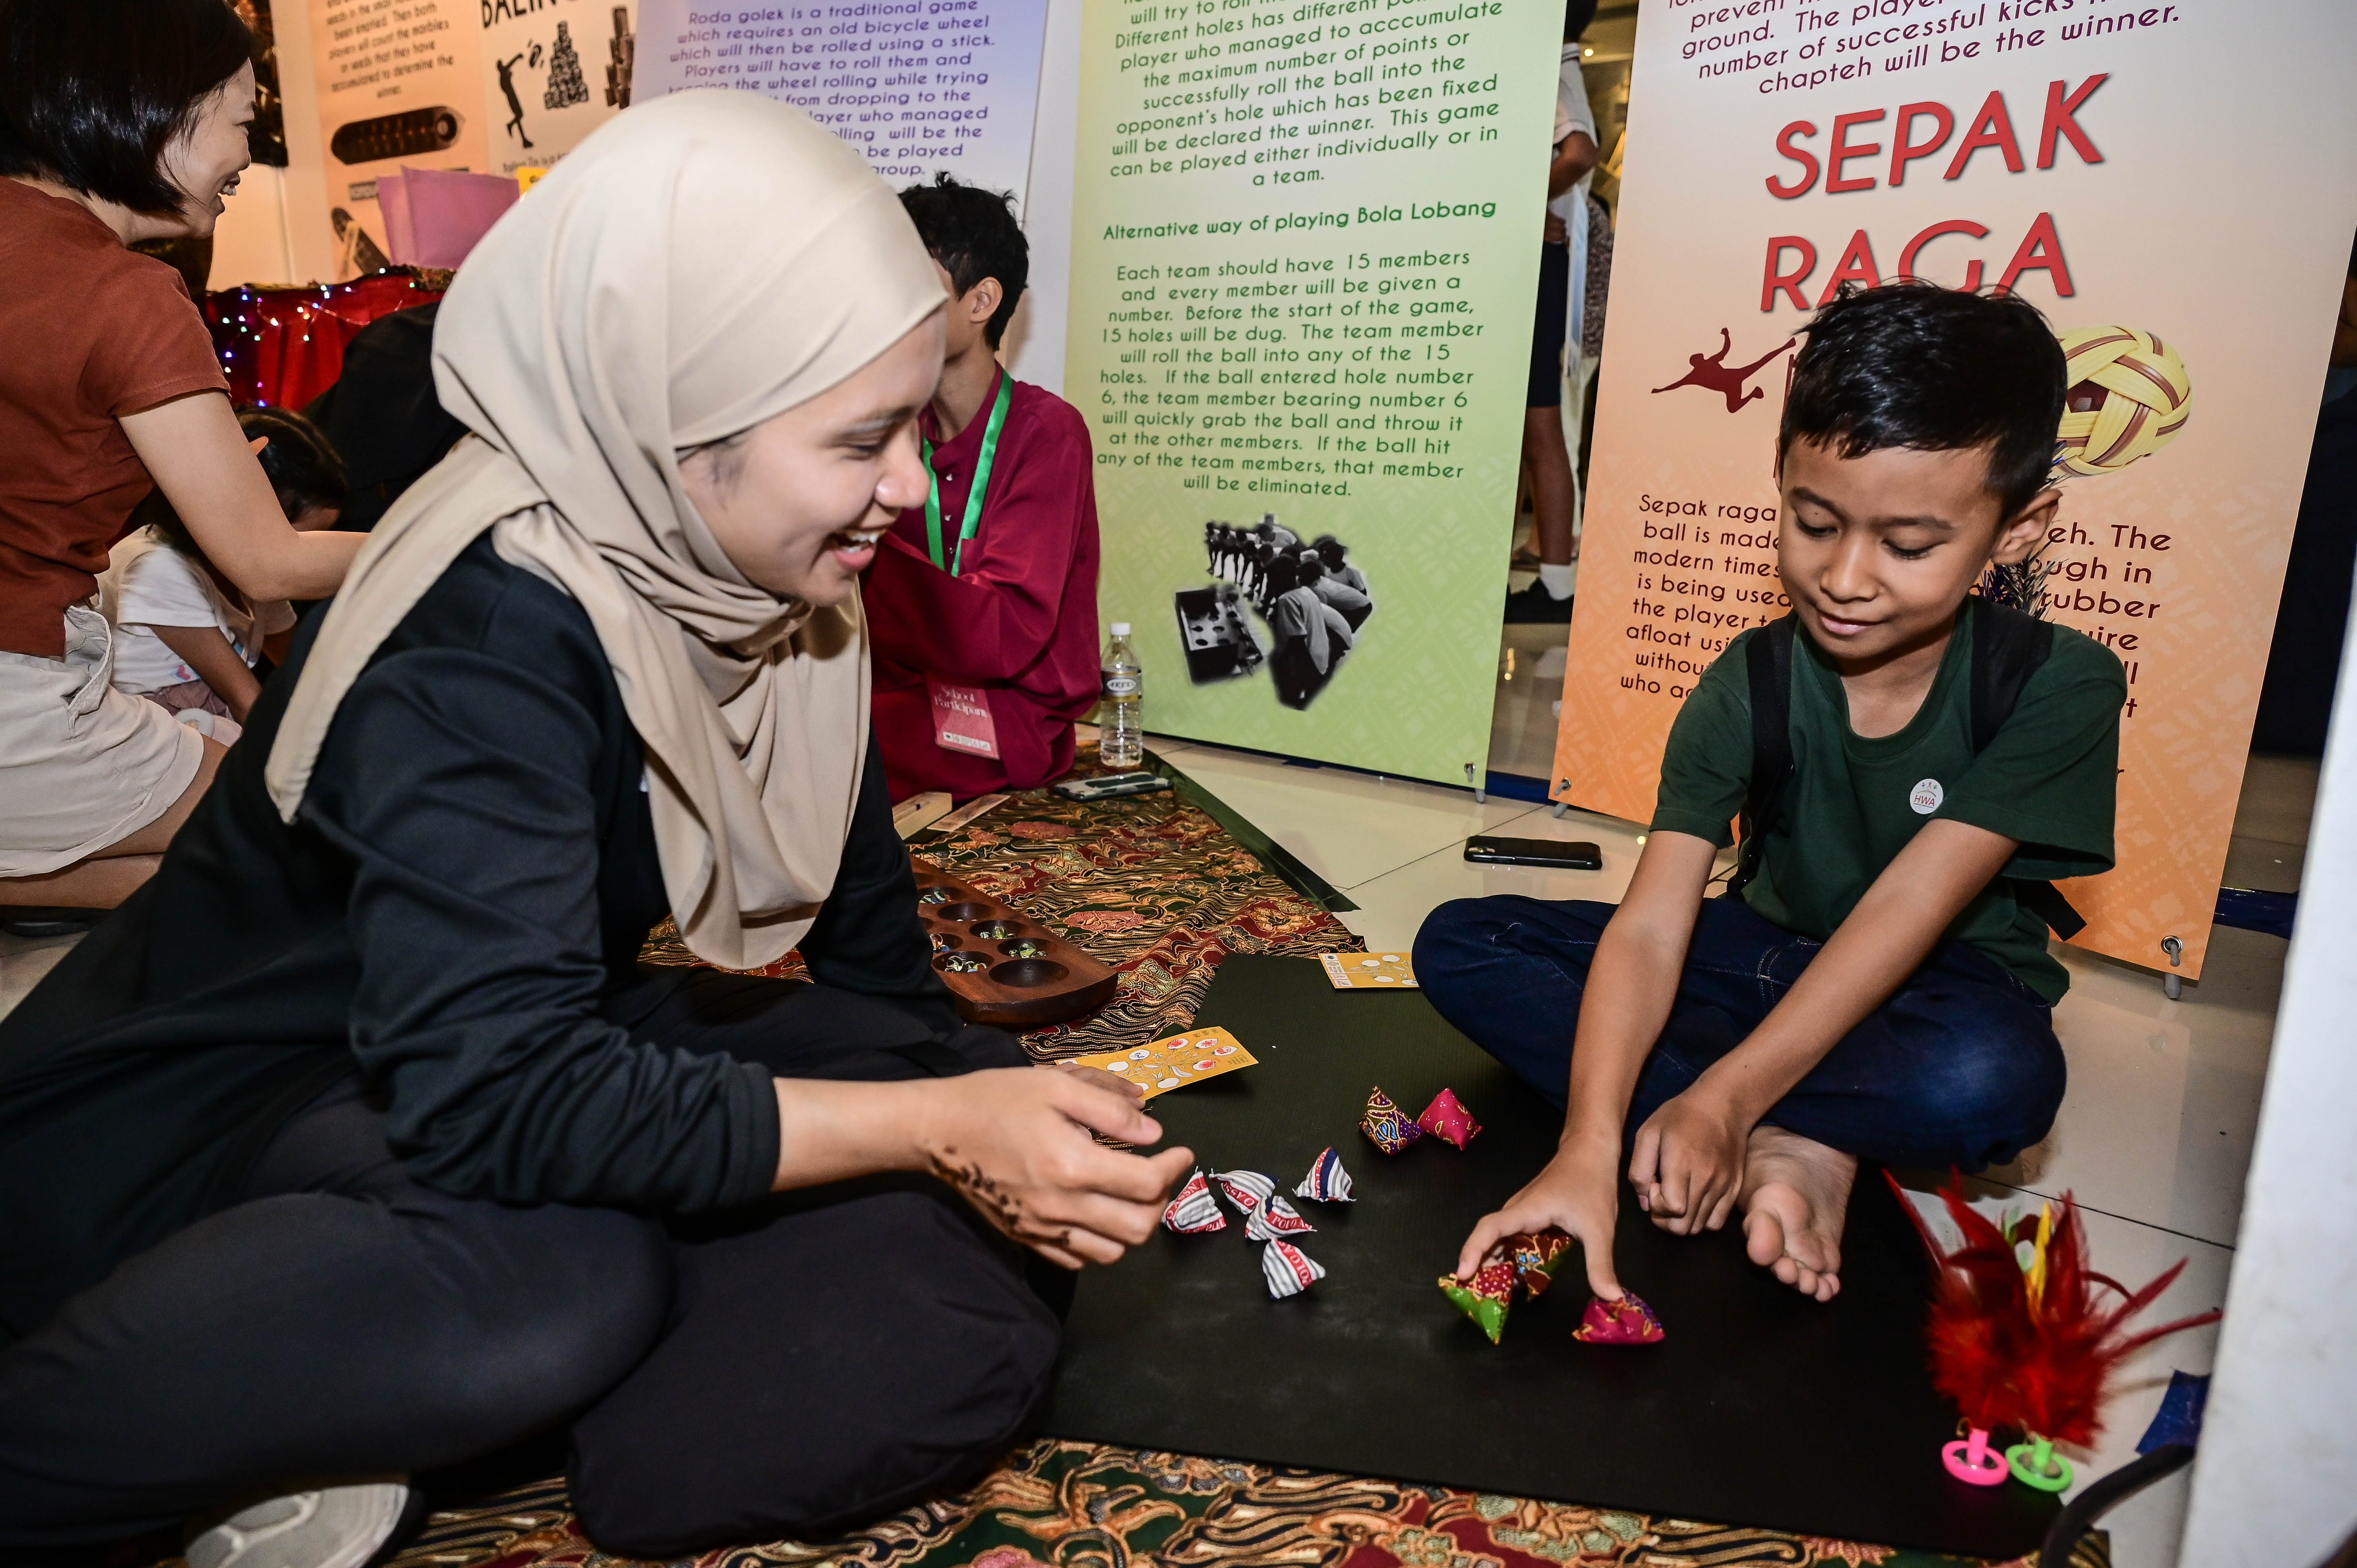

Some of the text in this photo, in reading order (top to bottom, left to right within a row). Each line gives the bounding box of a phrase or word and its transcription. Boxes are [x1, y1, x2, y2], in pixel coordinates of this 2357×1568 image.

[689, 0, 977, 24] Roda golek is a traditional game
[678, 15, 989, 44] which requires an old bicycle wheel
[1116, 13, 1284, 49] Different holes has
[1121, 52, 1177, 72] player
[1185, 44, 1220, 60] who
[1228, 26, 1321, 53] managed
[1331, 25, 1350, 39] to
[1360, 2, 1502, 34] acccumulate
[1683, 20, 1774, 59] ground.
[1795, 10, 1839, 32] The
[670, 35, 994, 62] which will then be rolled using a stick.
[1700, 50, 1788, 81] number
[1799, 36, 1826, 59] of
[1836, 9, 1985, 52] successful
[1760, 3, 2178, 93] chapteh will be the winner.
[1144, 33, 1469, 87] the maximum number of points or
[735, 78, 760, 90] the
[768, 76, 816, 89] wheel
[823, 74, 877, 89] rolling
[885, 72, 927, 85] while
[937, 72, 988, 85] trying
[860, 109, 894, 122] who
[901, 107, 988, 122] managed
[1117, 74, 1497, 136] opponent's hole which has been fixed
[889, 126, 916, 139] will
[923, 126, 945, 138] be
[955, 125, 981, 137] the
[1765, 72, 2110, 200] SEPAK
[867, 146, 889, 157] be
[898, 143, 963, 159] played
[1110, 126, 1497, 177] can be played either individually or in
[1104, 201, 1496, 239] Alternative way of playing Bola Lobang
[1117, 250, 1469, 280] Each team should have 15 members
[1760, 212, 2074, 313] RAGA
[1109, 299, 1473, 322] number. Before the start of the game,
[1121, 344, 1450, 364] will roll the ball into any of the 15
[1102, 389, 1467, 409] 6, the team member bearing number 6
[1110, 431, 1450, 454] at the other members. If the ball hit
[1639, 495, 1776, 523] Sepak raga
[1644, 521, 1686, 541] ball
[1696, 527, 1709, 543] is
[2111, 525, 2171, 551] The
[1634, 550, 1713, 570] modern
[2124, 562, 2151, 583] in
[1638, 573, 1651, 589] is
[1661, 574, 1725, 602] being
[1633, 598, 1665, 617] the
[1675, 604, 1749, 628] player
[1626, 624, 1691, 647] afloat
[1636, 653, 1712, 675] withou
[1621, 673, 1660, 693] who
[1914, 795, 1935, 806] HWA
